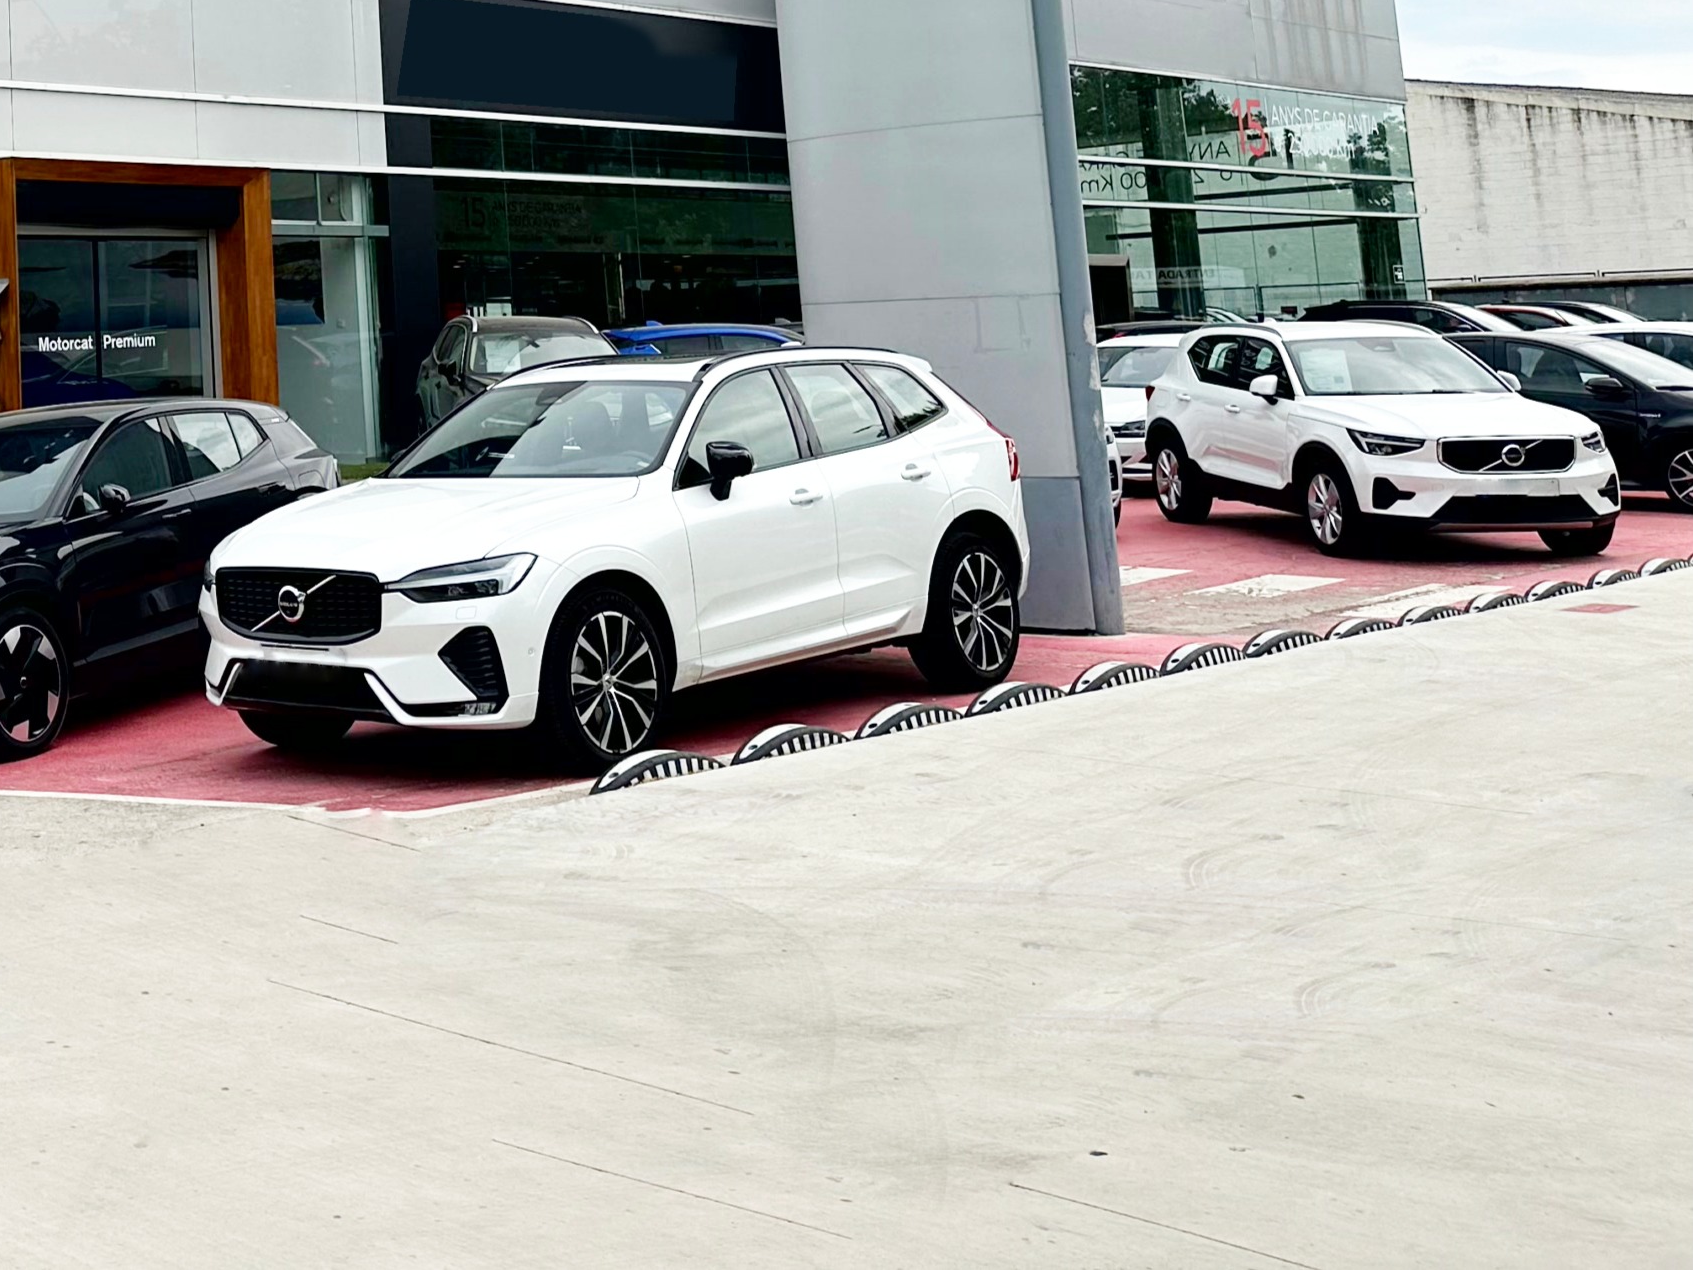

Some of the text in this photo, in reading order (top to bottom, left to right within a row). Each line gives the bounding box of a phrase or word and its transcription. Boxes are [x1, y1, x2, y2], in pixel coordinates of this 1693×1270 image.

[1231, 97, 1268, 158] 15
[1270, 104, 1303, 127] ANYS
[1304, 108, 1321, 131] DE
[37, 333, 156, 352] Motorcat Premium
